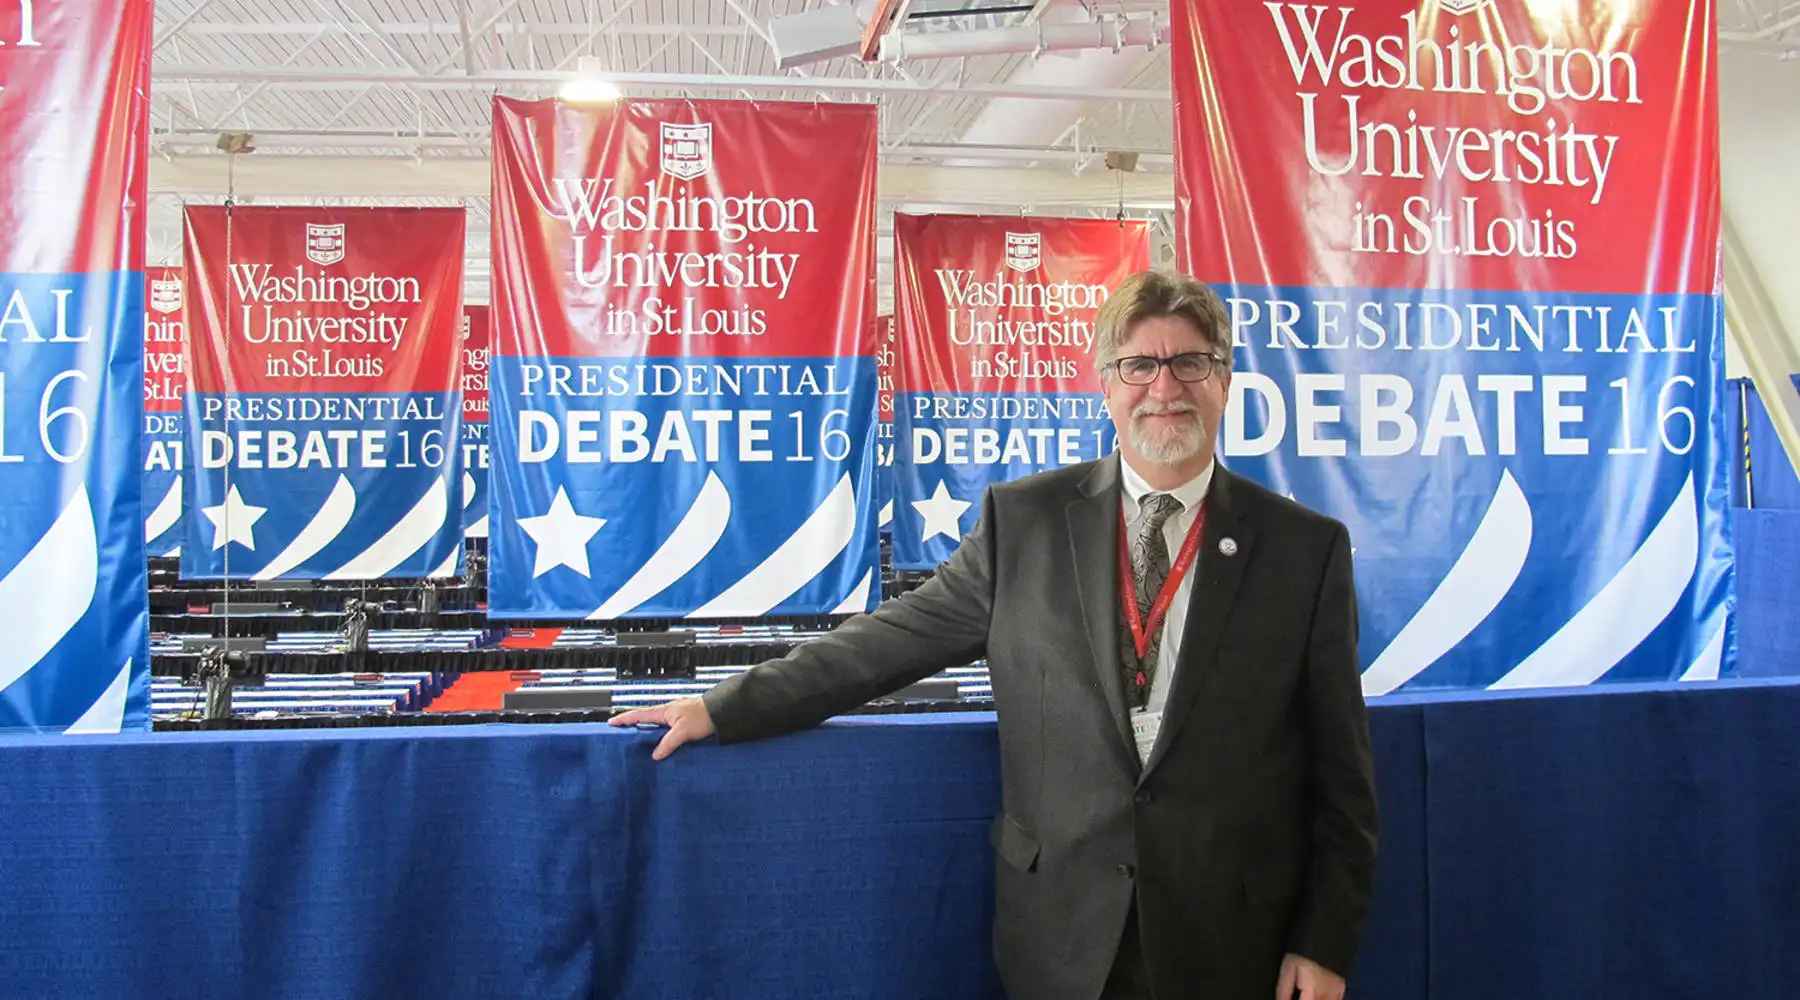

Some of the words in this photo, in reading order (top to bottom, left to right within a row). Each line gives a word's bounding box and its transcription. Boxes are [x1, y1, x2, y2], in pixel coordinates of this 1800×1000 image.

[1264, 0, 1642, 115] Washington
[1296, 92, 1617, 205] University
[553, 178, 818, 242] Washington
[1351, 202, 1397, 253] in
[230, 263, 421, 311] Washington
[572, 235, 800, 299] University
[934, 269, 1109, 316] Washington
[241, 305, 408, 350] University
[606, 302, 638, 335] in
[948, 308, 1097, 354] University
[1226, 297, 1696, 354] PRESIDENTIAL
[265, 353, 290, 377] in
[520, 364, 850, 397] PRESIDENTIAL
[971, 357, 992, 378] in
[203, 398, 445, 421] PRESIDENTIAL
[1224, 372, 1589, 457] DEBATE
[1607, 376, 1697, 456] 16
[202, 430, 387, 469] DEBATE
[395, 430, 444, 468] 16
[518, 409, 773, 463] DEBATE
[786, 409, 851, 461] 16
[912, 428, 1082, 465] DEBATE
